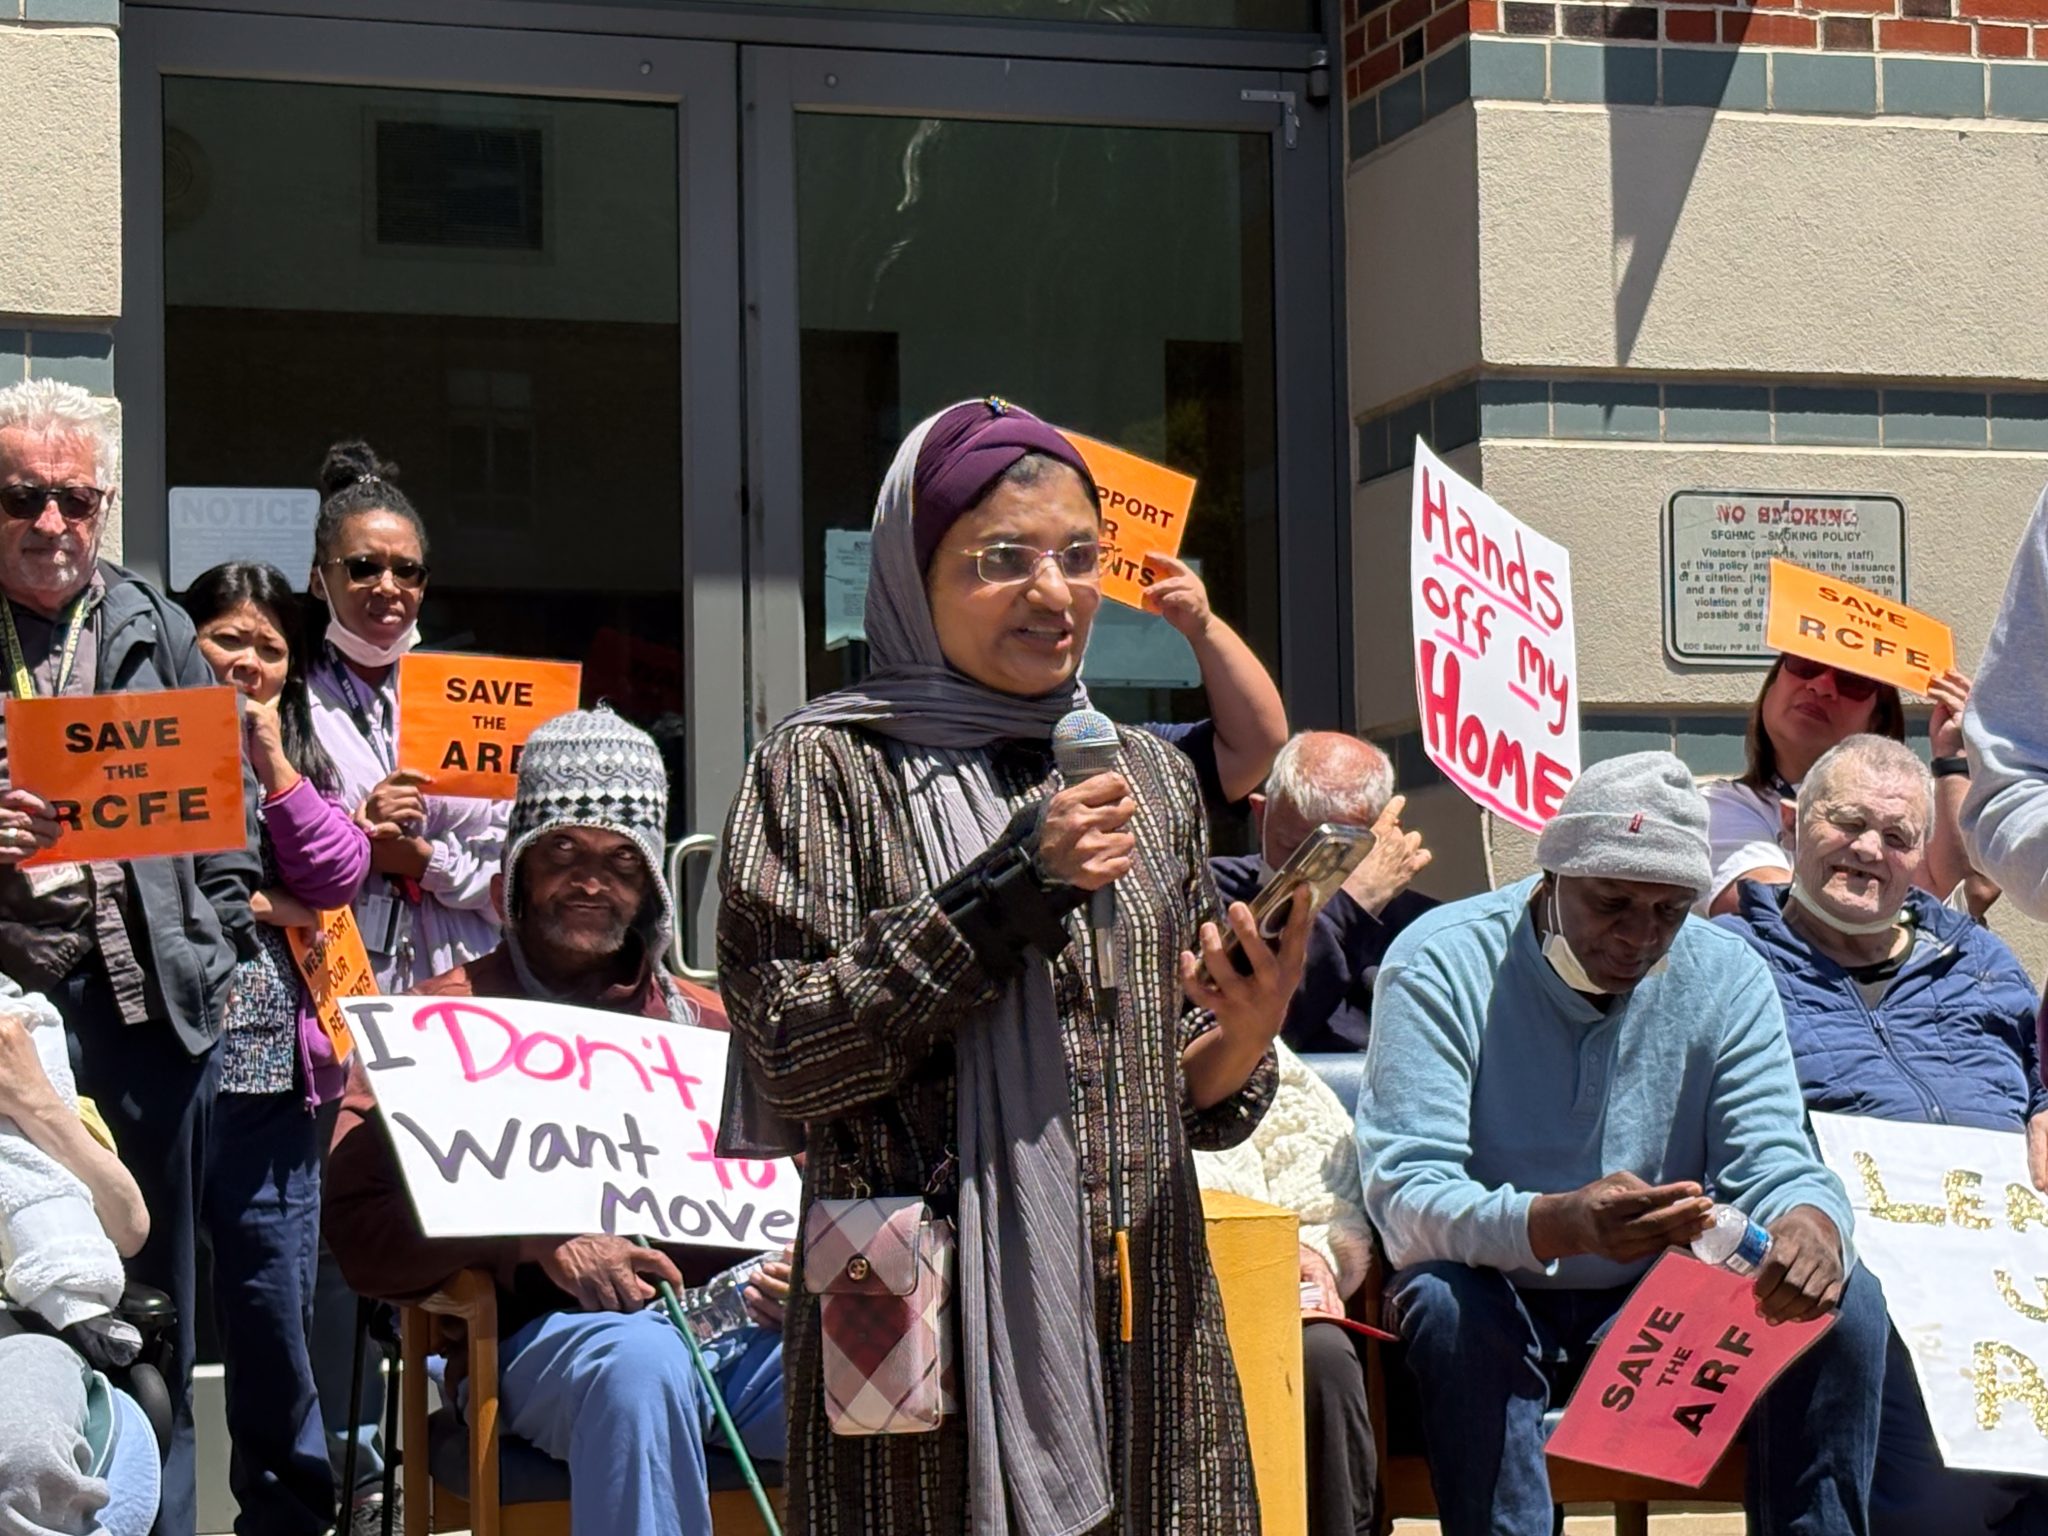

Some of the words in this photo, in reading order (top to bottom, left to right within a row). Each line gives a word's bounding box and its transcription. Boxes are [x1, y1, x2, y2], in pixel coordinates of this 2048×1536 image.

[179, 496, 310, 525] NOTICE
[1096, 485, 1174, 528] PPORT
[1716, 505, 1746, 524] NO
[1421, 465, 1564, 631] Hands
[1711, 530, 1756, 540] SFGHMC
[1822, 532, 1861, 542] POLICY
[1680, 561, 1691, 570] of
[1696, 560, 1714, 570] this
[1719, 561, 1748, 572] policy
[1816, 562, 1826, 571] to
[1831, 562, 1846, 572] the
[1851, 562, 1895, 572] issuance
[1702, 548, 1747, 558] Violators
[1802, 549, 1842, 560] visitors,
[1847, 550, 1874, 561] staff)
[1686, 585, 1705, 594] and
[1720, 585, 1739, 594] fine
[1744, 585, 1754, 594] of
[1695, 574, 1701, 582] a
[1705, 573, 1746, 582] citation.
[1421, 576, 1497, 656] off
[1695, 598, 1737, 607] violation
[1742, 598, 1752, 607] of
[1696, 611, 1739, 621] possible
[1818, 586, 1908, 630] SAVE
[1846, 613, 1883, 632] THE
[1703, 643, 1727, 652] Safety
[1799, 614, 1931, 672] RCFE
[446, 677, 534, 708] SAVE
[65, 716, 181, 753] SAVE
[472, 715, 507, 731] THE
[1420, 638, 1573, 821] HOME
[103, 762, 149, 780] THE
[50, 786, 211, 832] RCFE
[328, 956, 350, 988] OUR
[345, 1002, 416, 1071] I
[412, 1002, 702, 1111] Don't
[391, 1112, 660, 1184] Want
[1601, 1305, 1685, 1412] SAVE
[1656, 1347, 1693, 1387] THE
[1672, 1325, 1755, 1438] ARF
